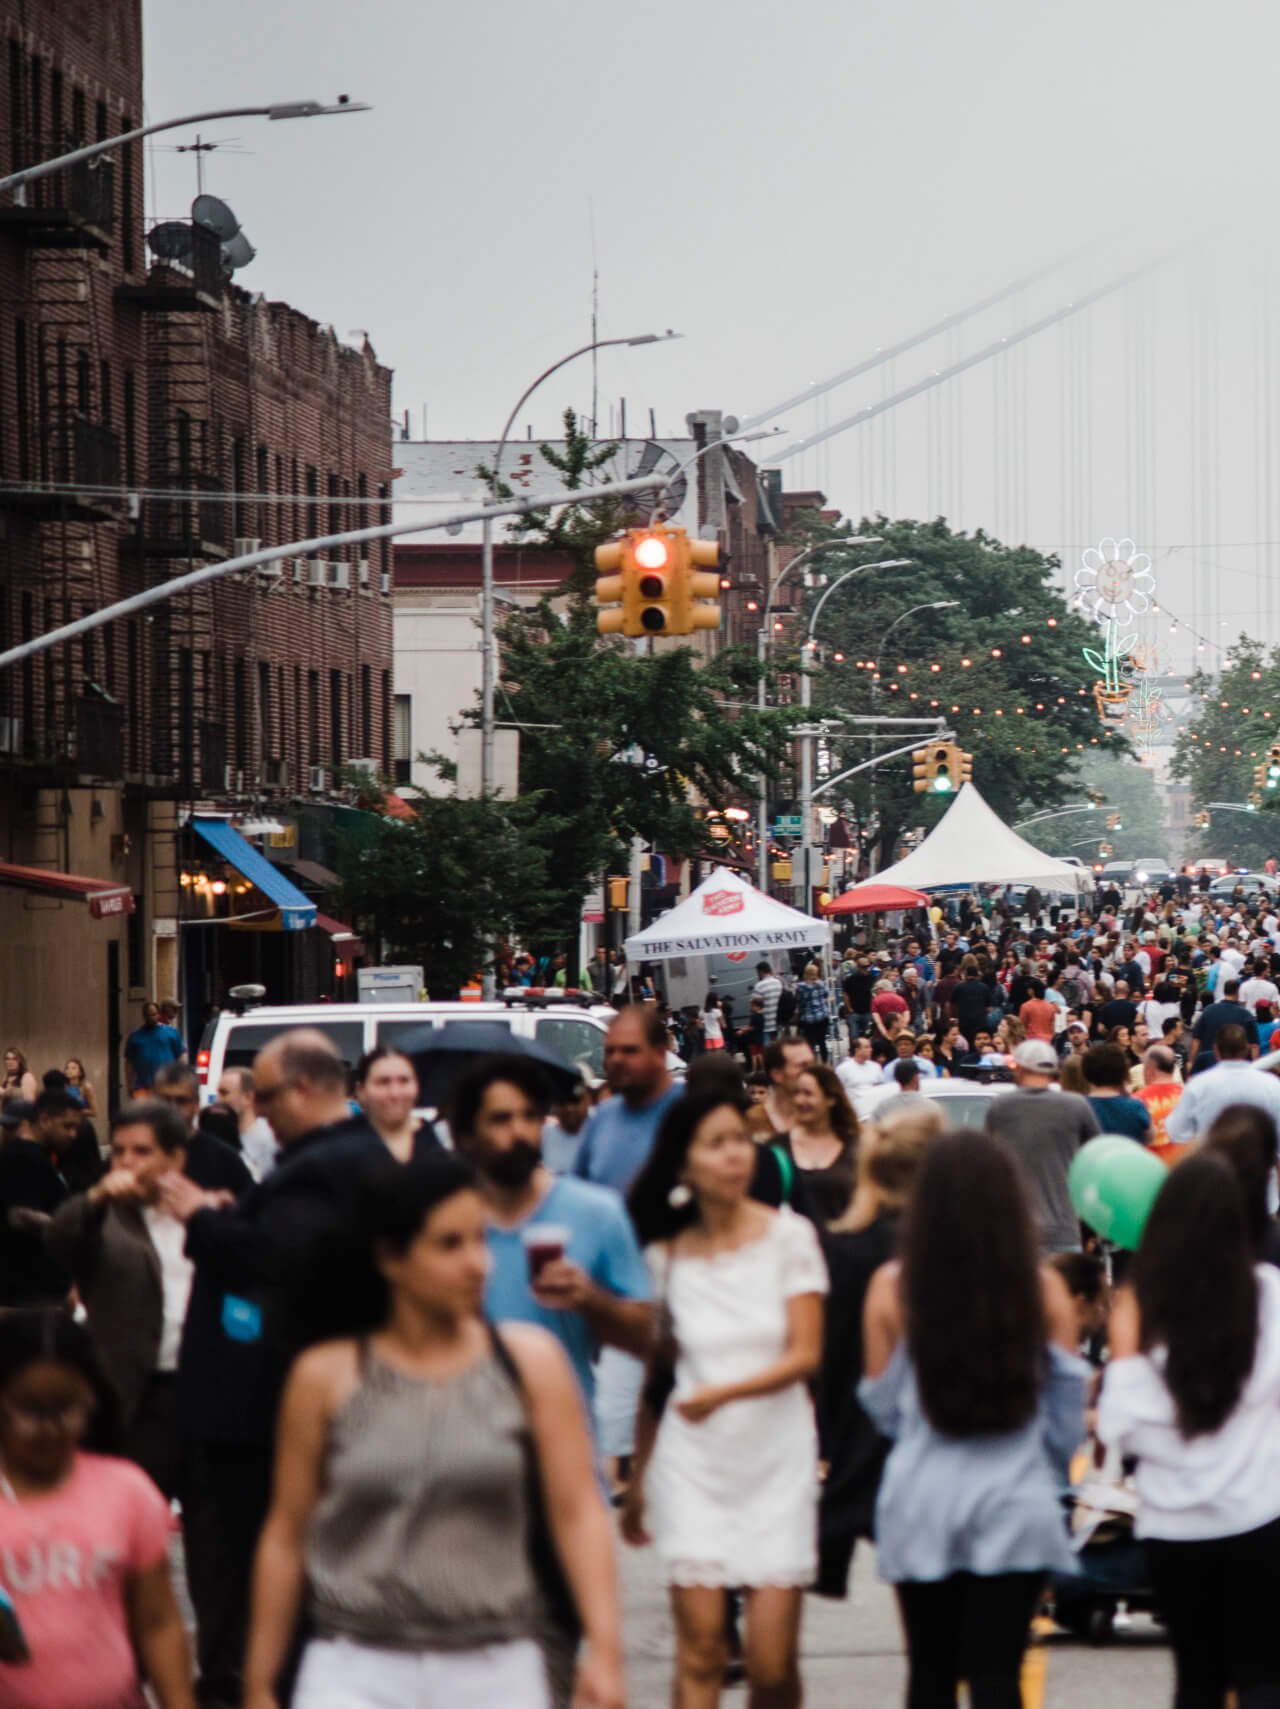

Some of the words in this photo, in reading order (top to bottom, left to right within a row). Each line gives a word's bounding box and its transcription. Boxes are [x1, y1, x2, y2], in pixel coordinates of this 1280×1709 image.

[642, 941, 673, 955] THE
[676, 934, 760, 950] SALVATION
[762, 930, 808, 944] ARMY
